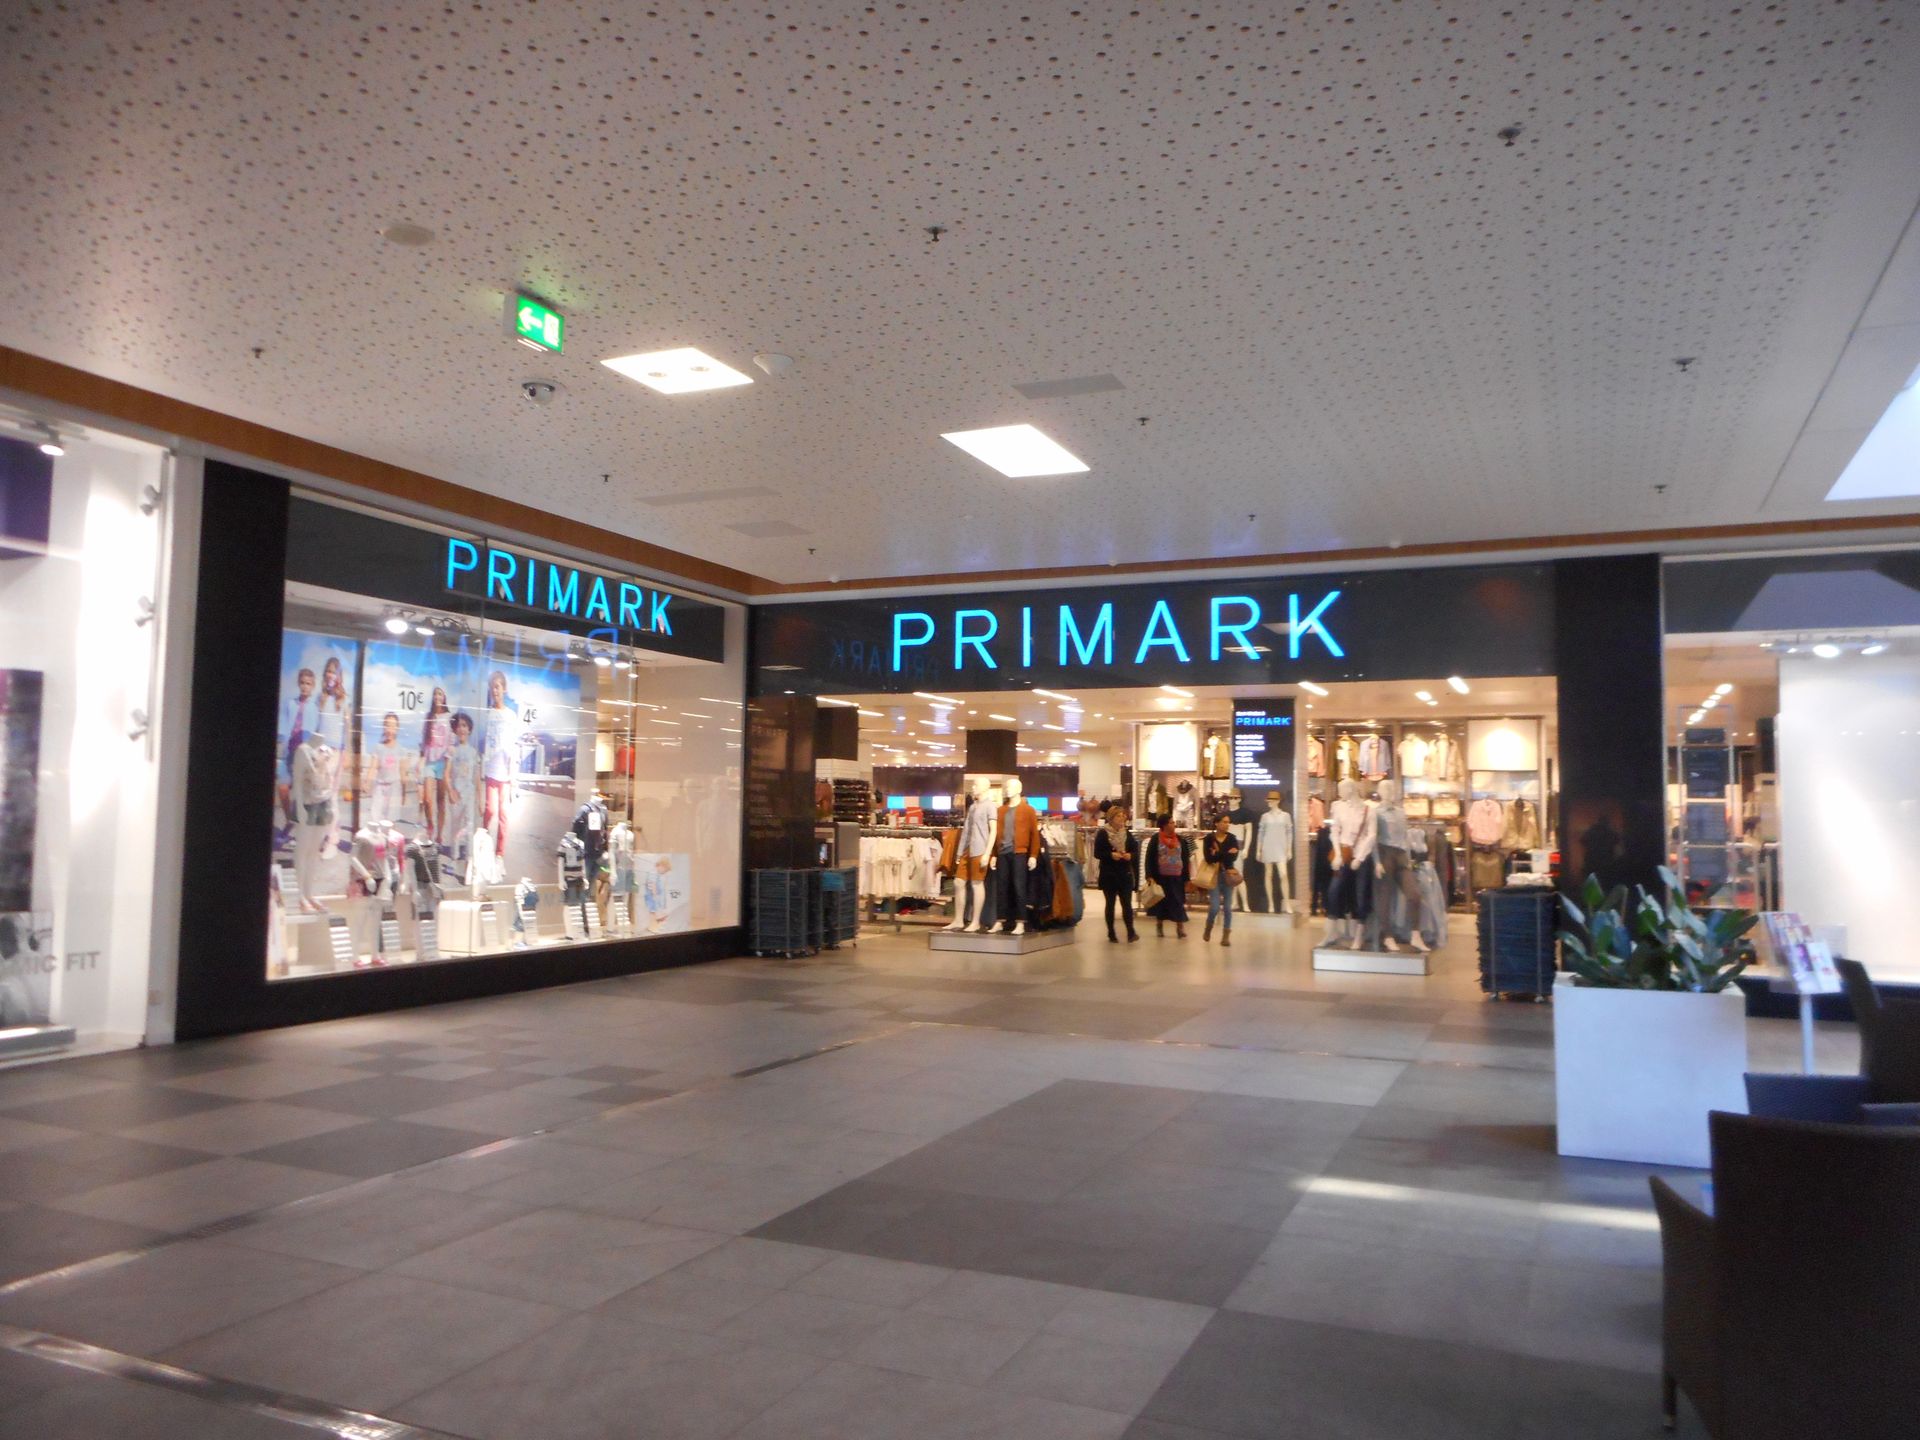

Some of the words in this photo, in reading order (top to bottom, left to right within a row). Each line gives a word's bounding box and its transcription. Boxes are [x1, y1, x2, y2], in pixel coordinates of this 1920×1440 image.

[447, 538, 673, 636] PRIMARK
[892, 590, 1345, 672] PRIMARK
[398, 690, 424, 710] 10€
[1235, 716, 1290, 727] PRIMARK
[65, 950, 101, 971] FIT
